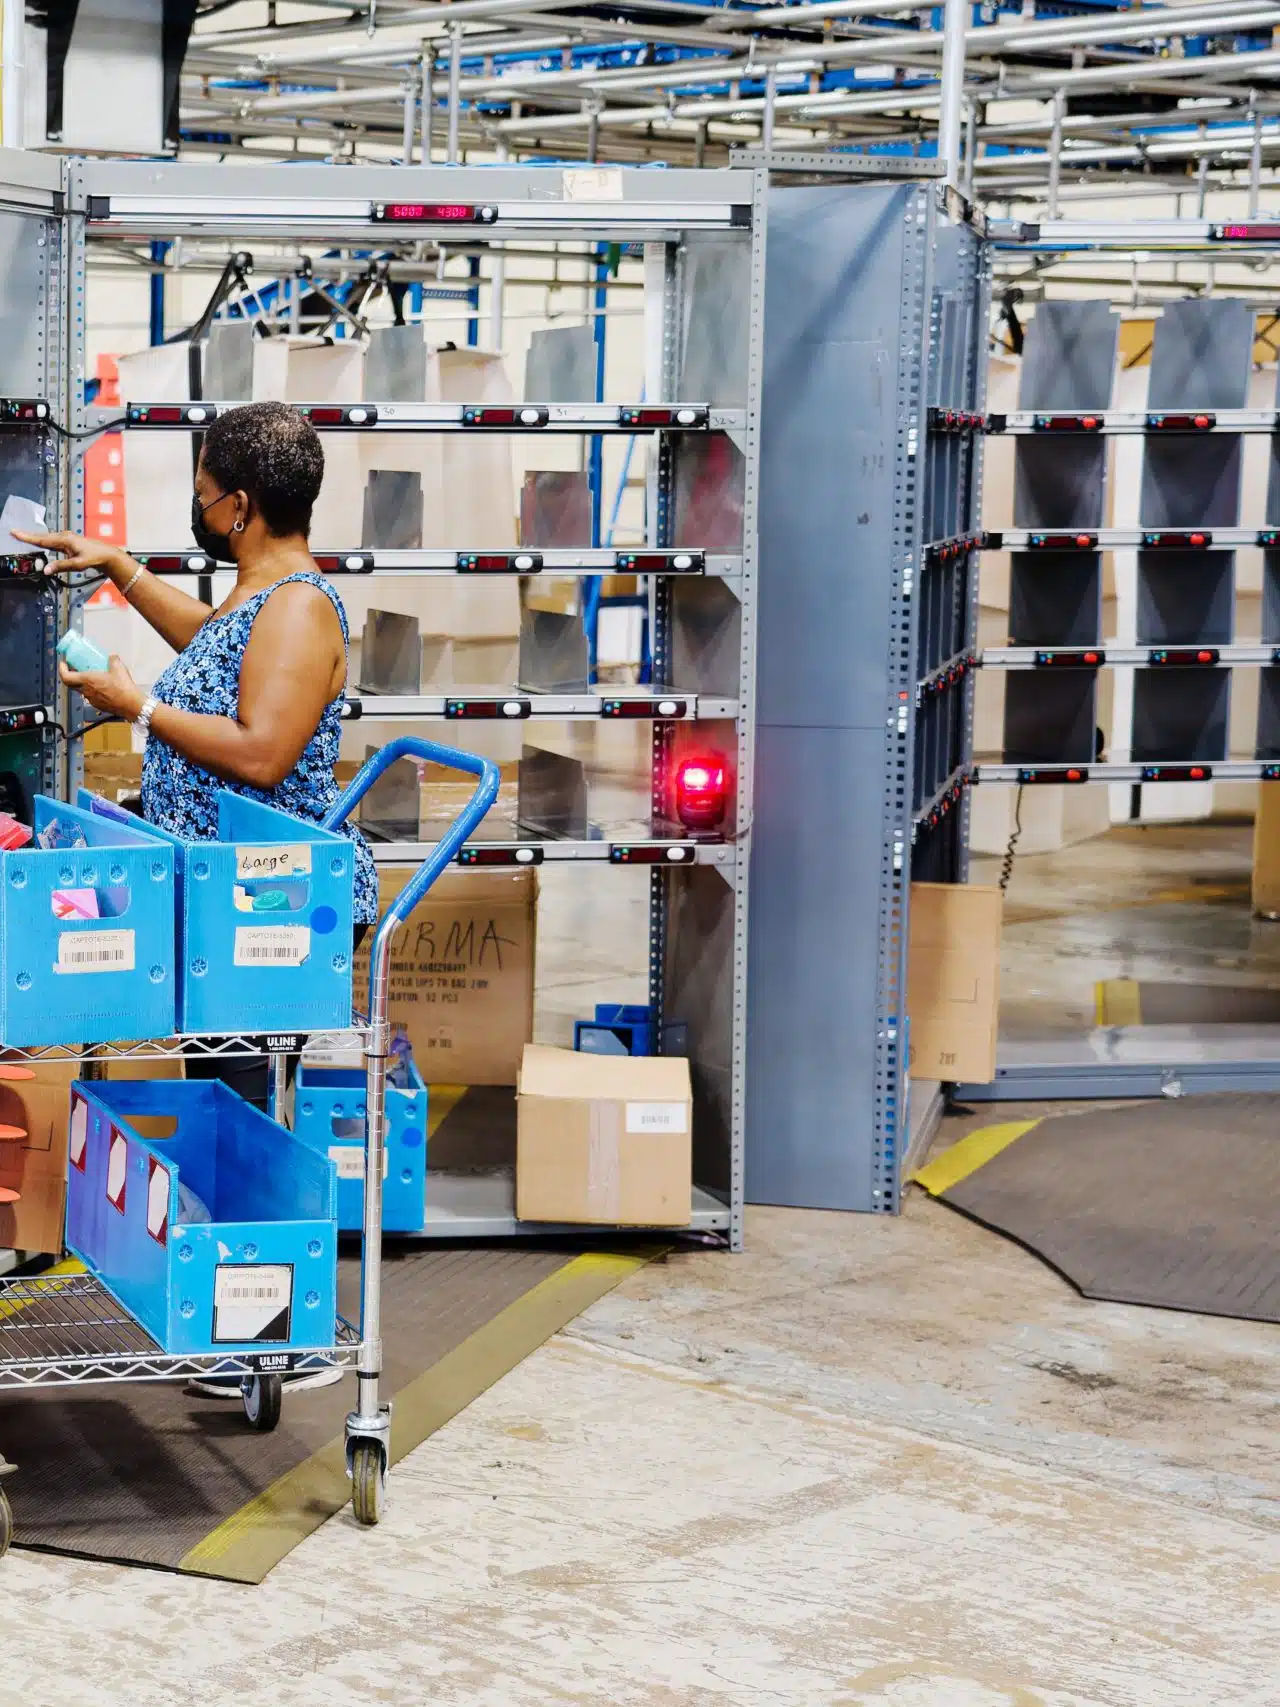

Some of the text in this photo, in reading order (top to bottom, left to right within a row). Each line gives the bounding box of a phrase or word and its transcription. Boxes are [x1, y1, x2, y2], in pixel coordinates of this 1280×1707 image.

[242, 853, 289, 872] Large
[266, 1036, 297, 1047] ULINE
[259, 1355, 289, 1366] ULINE
